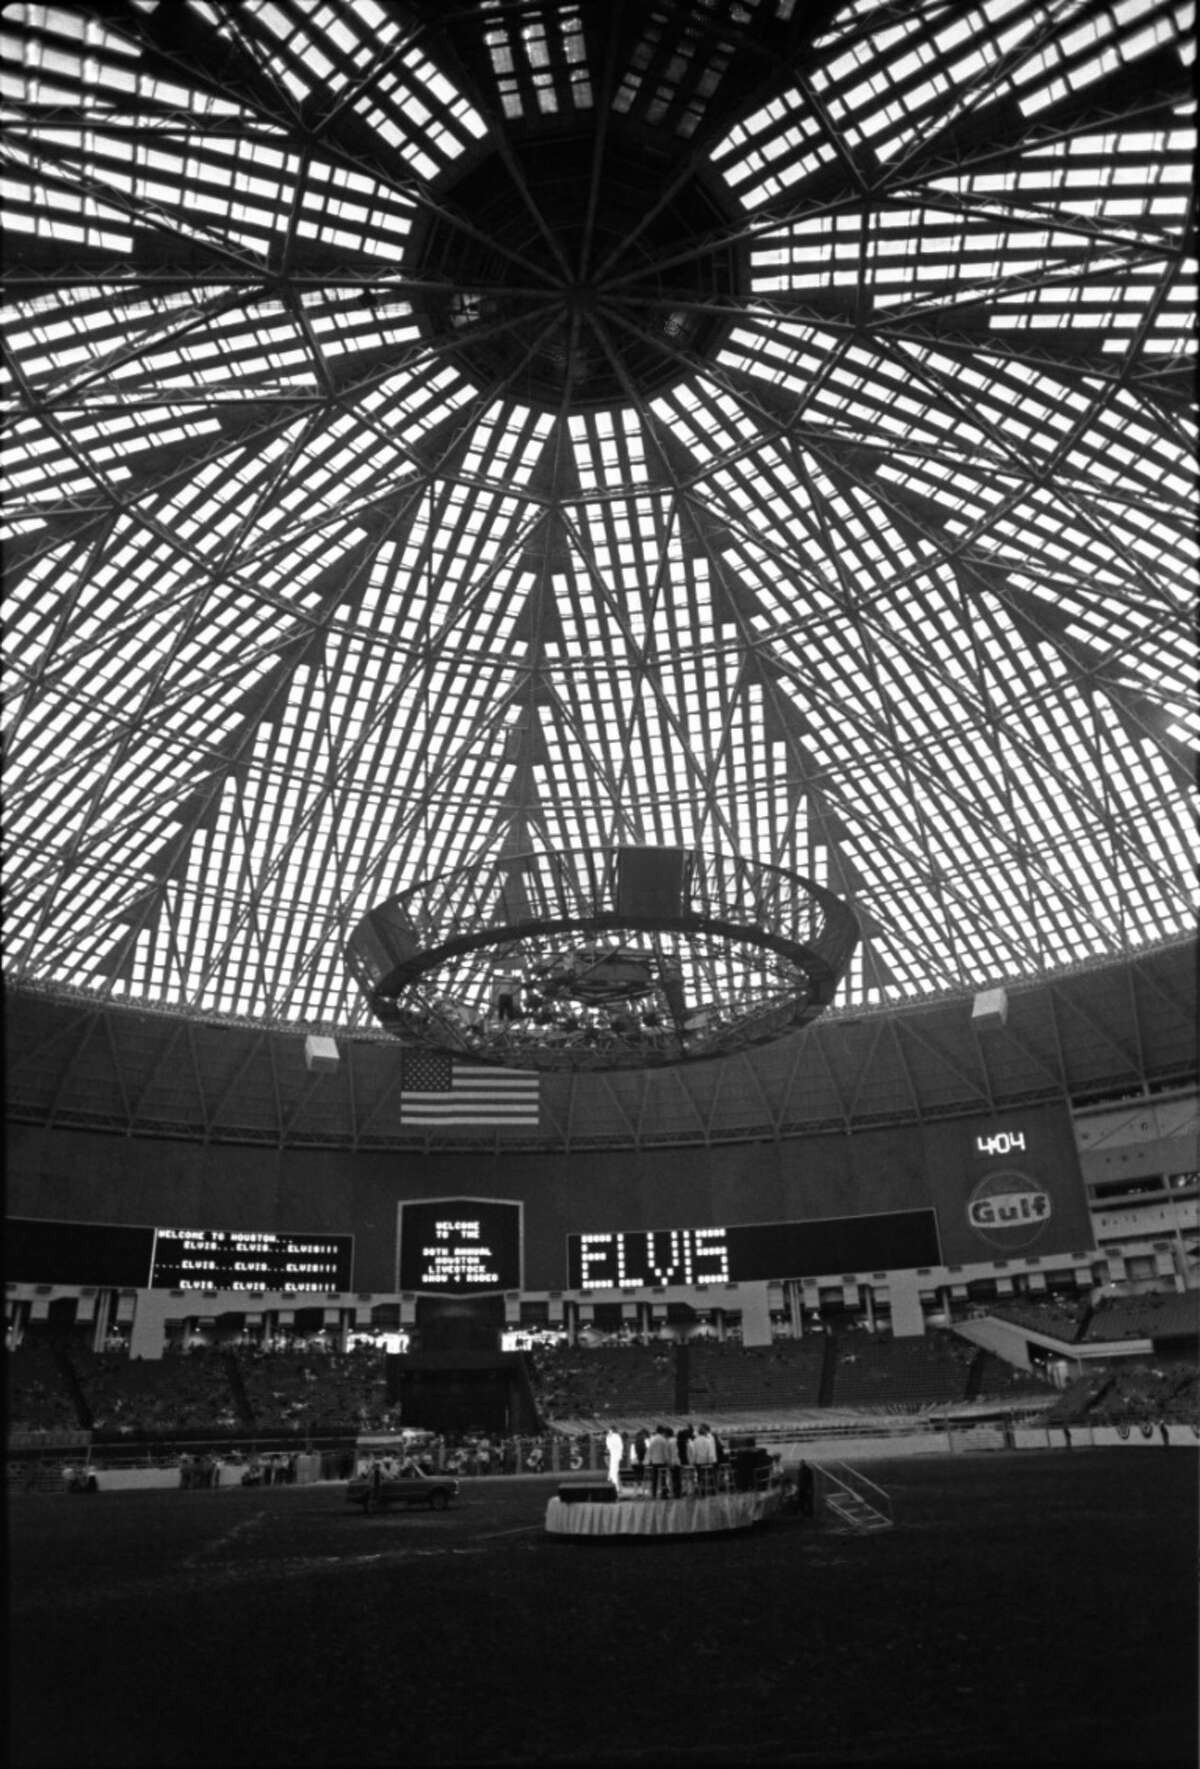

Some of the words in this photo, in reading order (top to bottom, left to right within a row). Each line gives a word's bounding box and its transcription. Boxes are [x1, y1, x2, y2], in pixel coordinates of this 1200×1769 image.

[972, 1195, 1047, 1223] Gulf
[435, 1221, 479, 1230] WELCOME
[158, 1229, 204, 1240] WELCOME
[212, 1232, 224, 1241] TO
[436, 1230, 449, 1239] TO
[461, 1230, 479, 1239] THE
[435, 1256, 480, 1264] HOUSTON
[581, 1228, 729, 1289] ELVIS
[428, 1265, 486, 1274] LIVESTOCK
[422, 1274, 448, 1283] SHOW
[466, 1273, 499, 1282] RODEO
